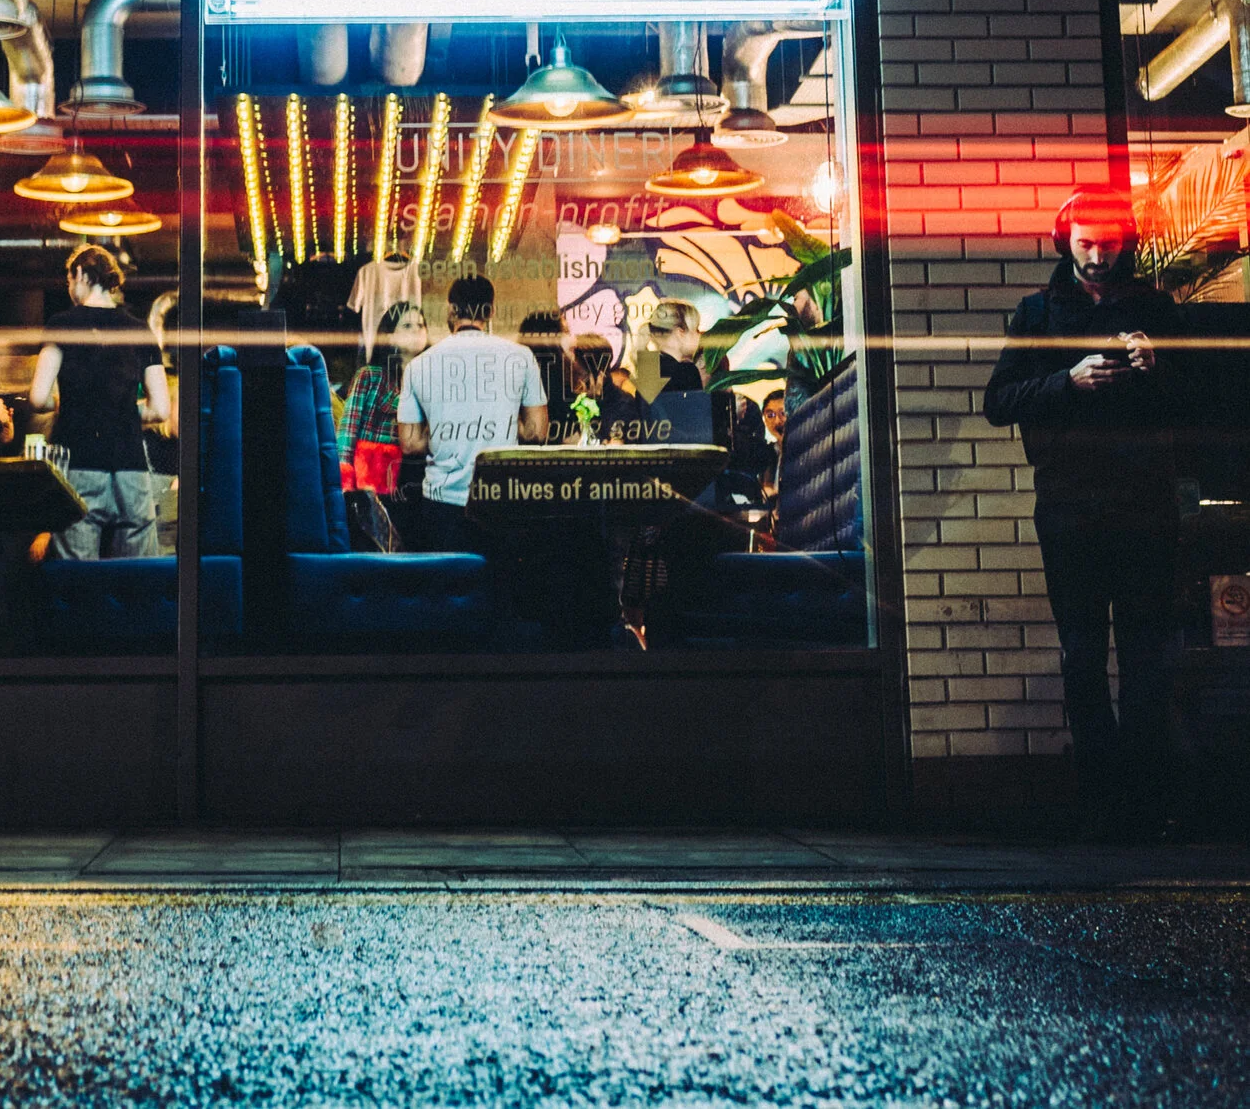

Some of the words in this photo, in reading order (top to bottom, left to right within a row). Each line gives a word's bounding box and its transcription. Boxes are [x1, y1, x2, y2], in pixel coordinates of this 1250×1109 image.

[396, 132, 517, 173] UNITY
[538, 131, 665, 172] DINER
[418, 260, 478, 286] egan
[485, 252, 666, 280] establishment
[387, 352, 613, 402] DIRECTLY
[616, 418, 672, 441] save
[470, 478, 501, 501] the
[508, 478, 554, 501] lives
[560, 478, 582, 501] of
[590, 478, 681, 501] animals.
